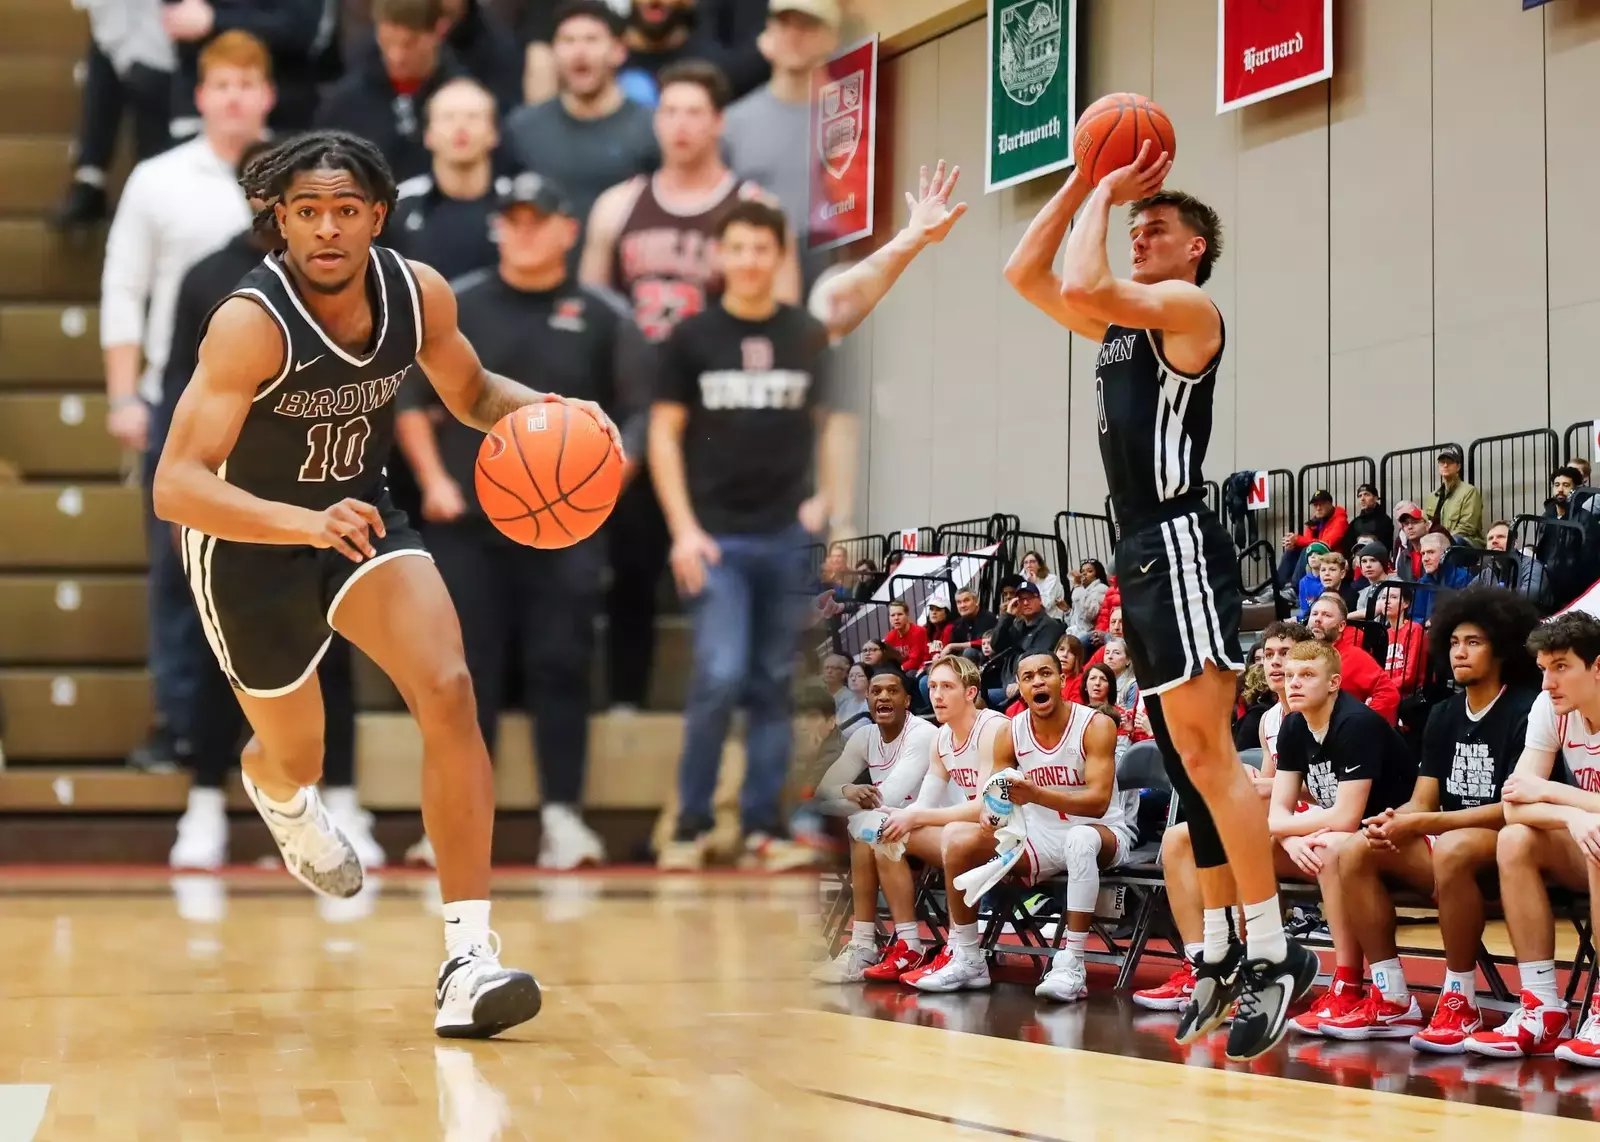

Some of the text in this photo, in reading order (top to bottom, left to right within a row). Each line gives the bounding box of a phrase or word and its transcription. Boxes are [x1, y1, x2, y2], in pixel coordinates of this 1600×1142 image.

[1243, 31, 1303, 74] Harvard
[998, 115, 1060, 155] Dartmouth
[820, 191, 855, 220] Cornell
[297, 415, 371, 482] 10
[1248, 477, 1265, 504] N
[902, 533, 917, 552] M
